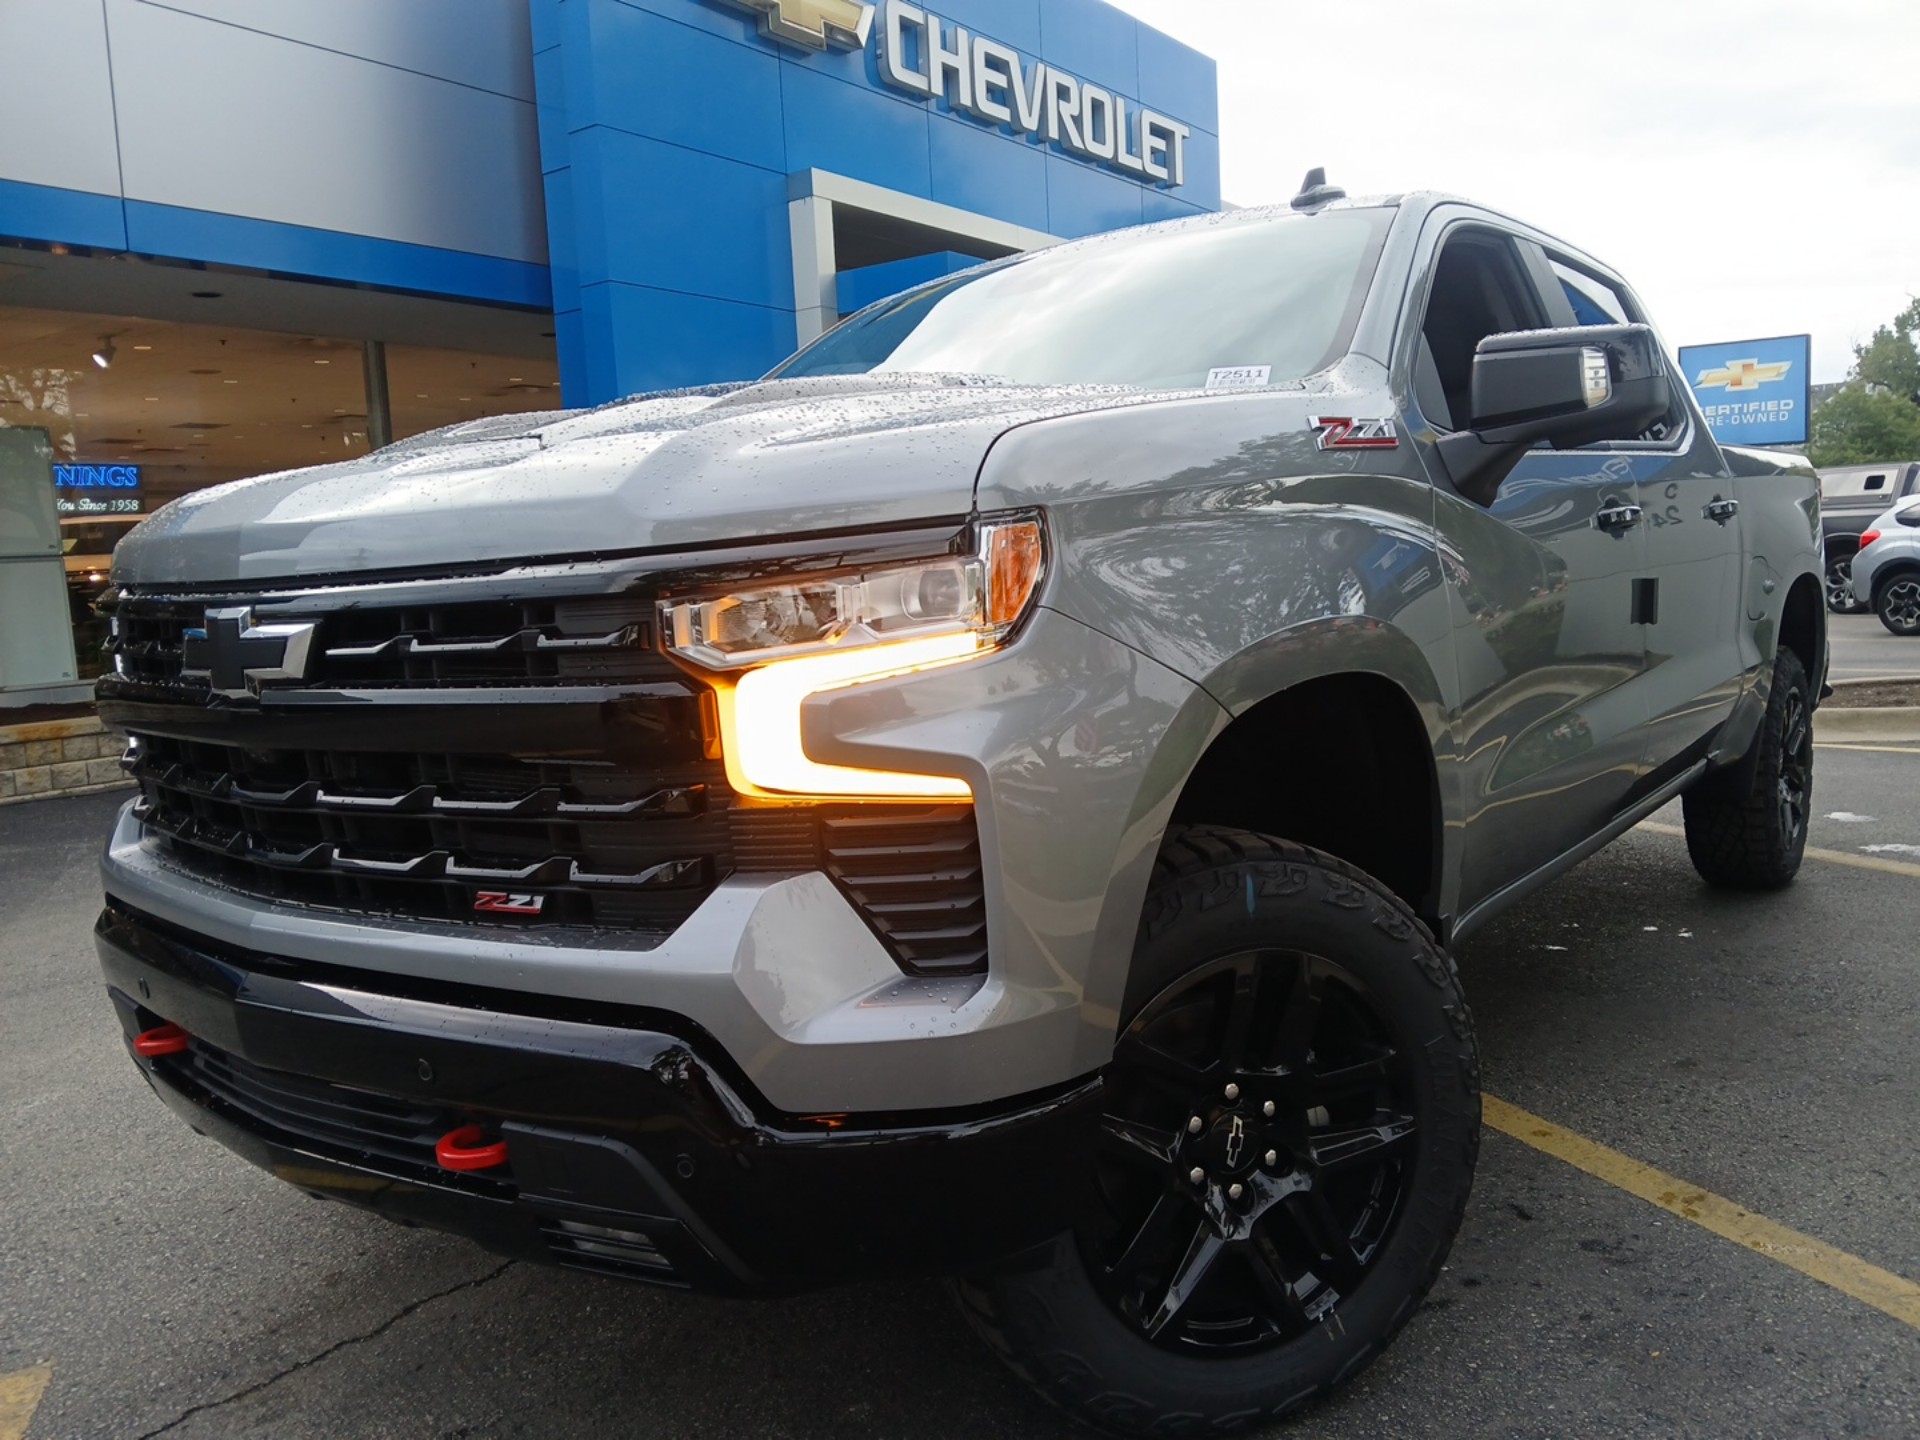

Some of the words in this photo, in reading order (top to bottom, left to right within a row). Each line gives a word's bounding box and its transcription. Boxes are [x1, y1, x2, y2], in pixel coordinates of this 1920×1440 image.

[882, 0, 1190, 187] CHEVROLET
[1308, 416, 1399, 450] Z71
[78, 498, 107, 511] Since
[110, 499, 139, 511] 1958
[474, 891, 544, 914] Z71
